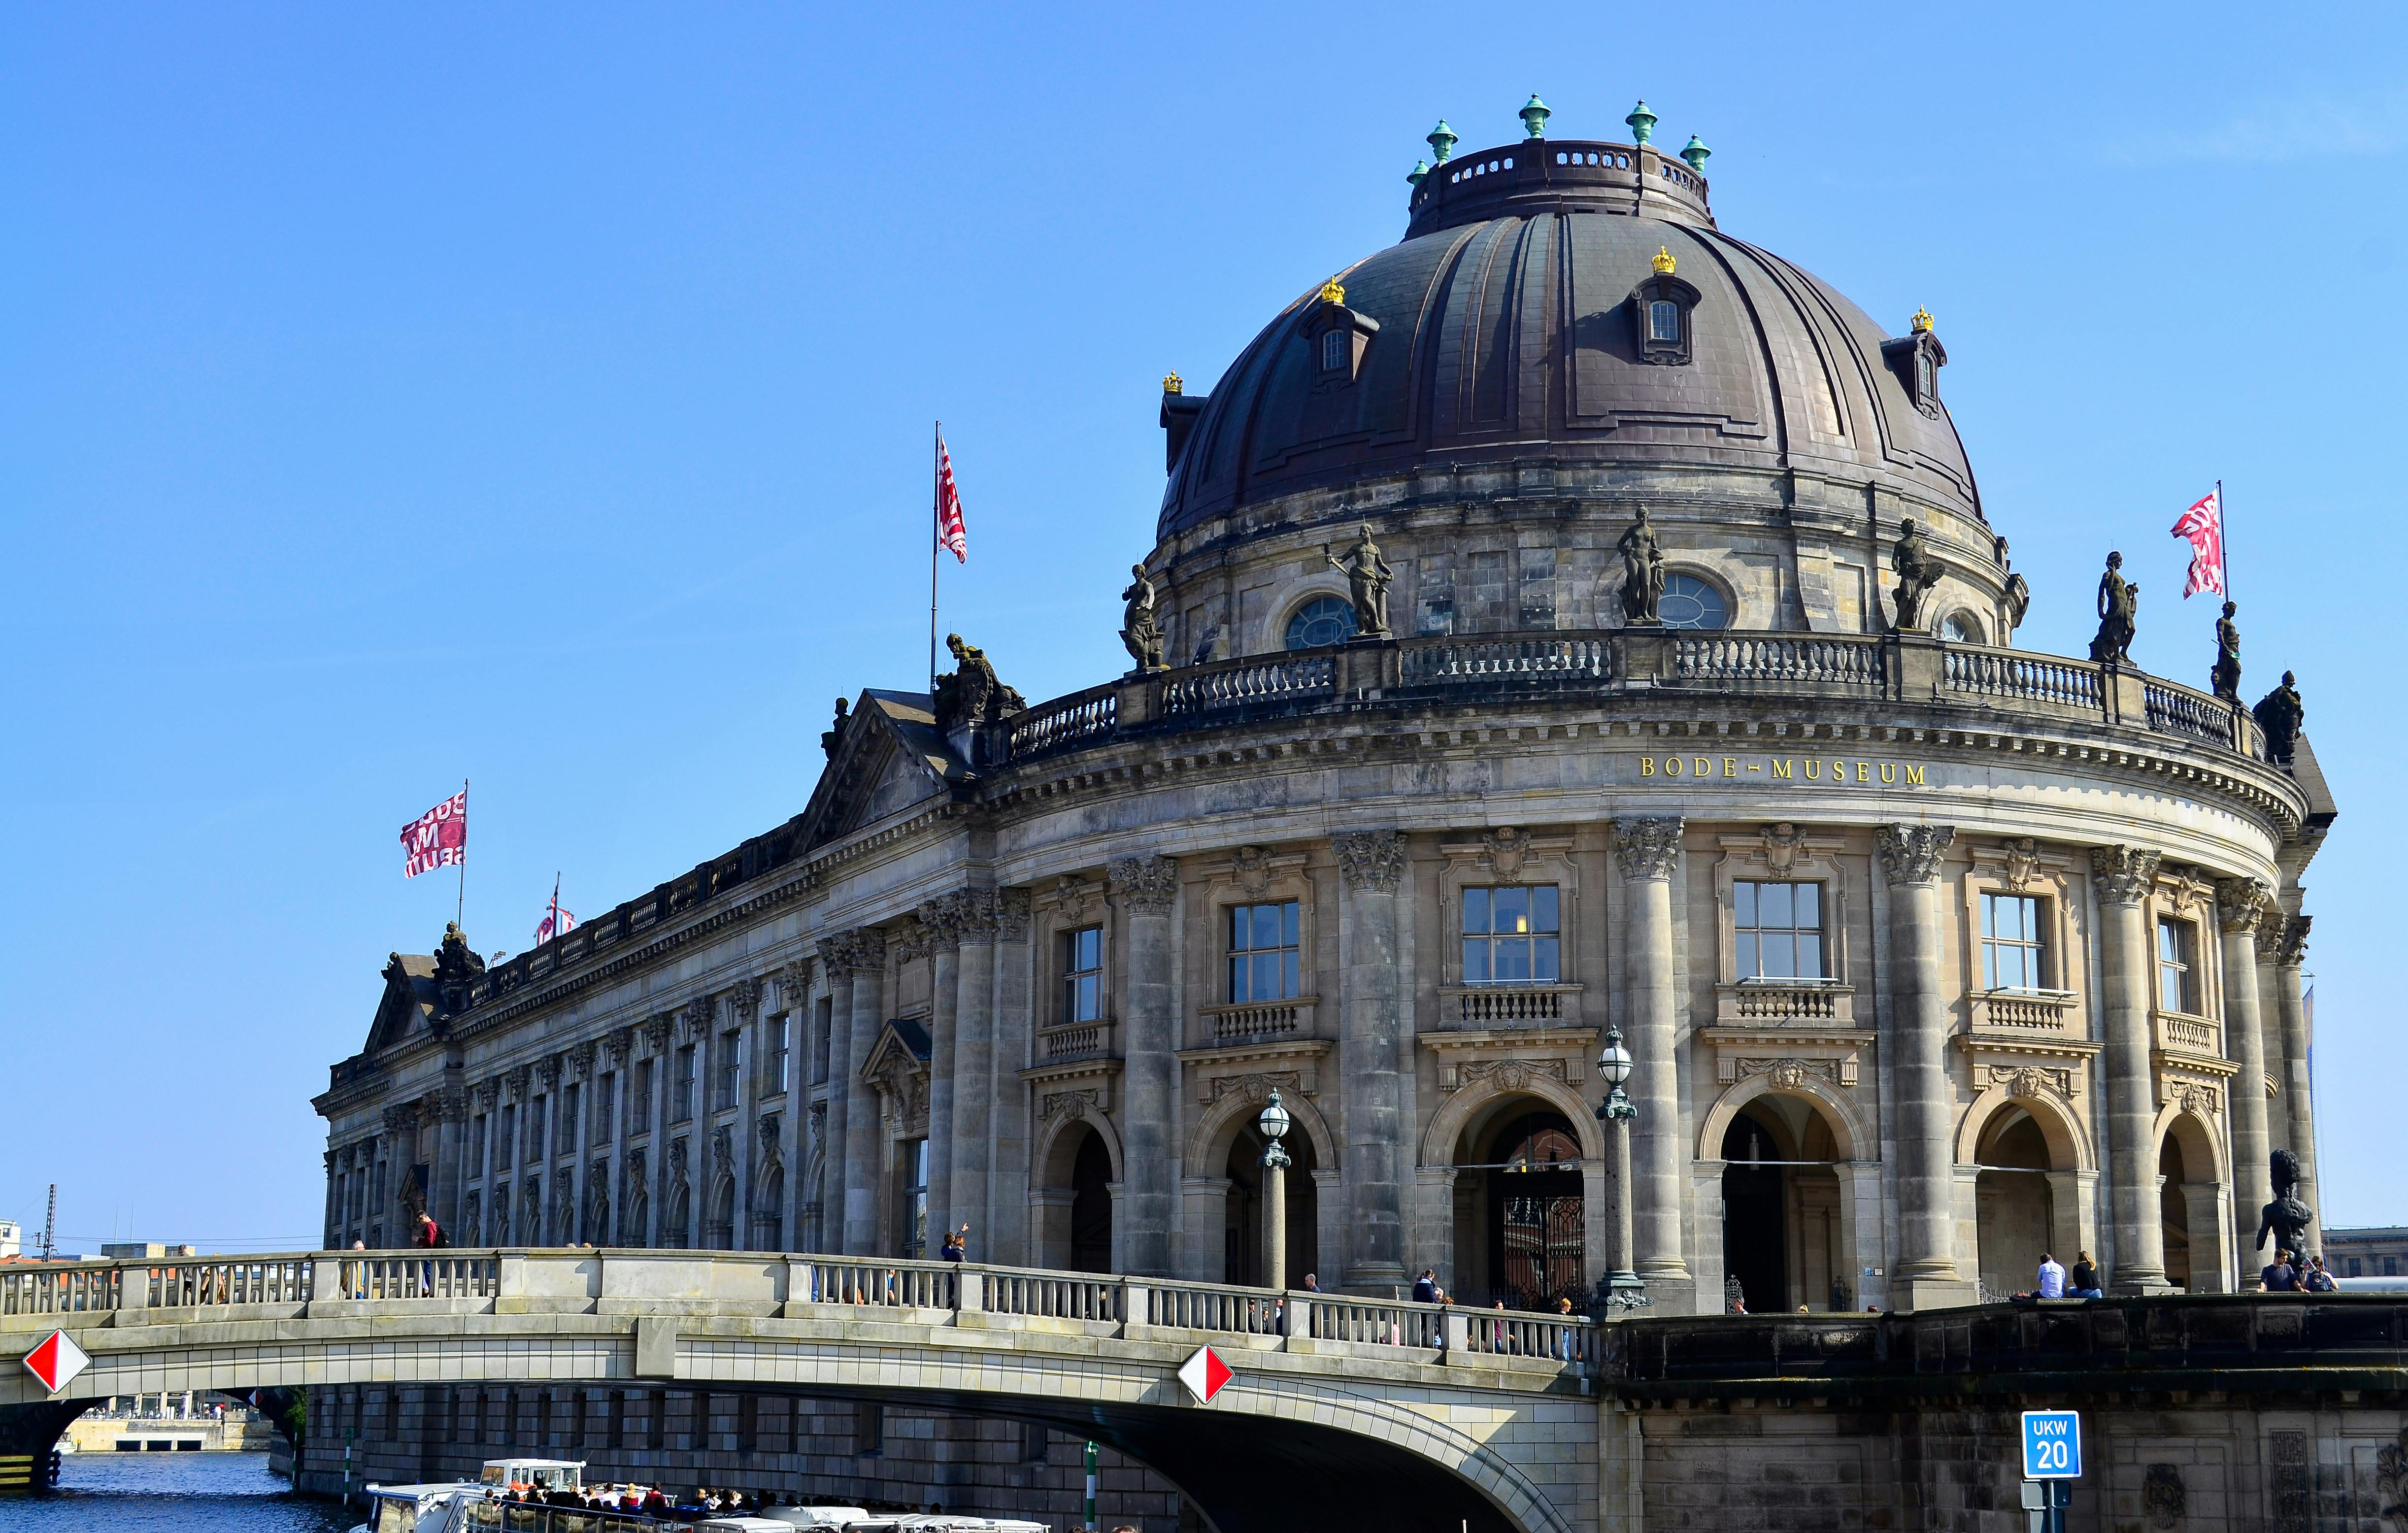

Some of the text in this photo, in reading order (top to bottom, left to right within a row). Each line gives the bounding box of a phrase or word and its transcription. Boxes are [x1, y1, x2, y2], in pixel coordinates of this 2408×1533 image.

[1640, 757, 1925, 785] BODE-MUSEUM
[2033, 1420, 2068, 1436] UKW
[2037, 1440, 2068, 1469] 20
